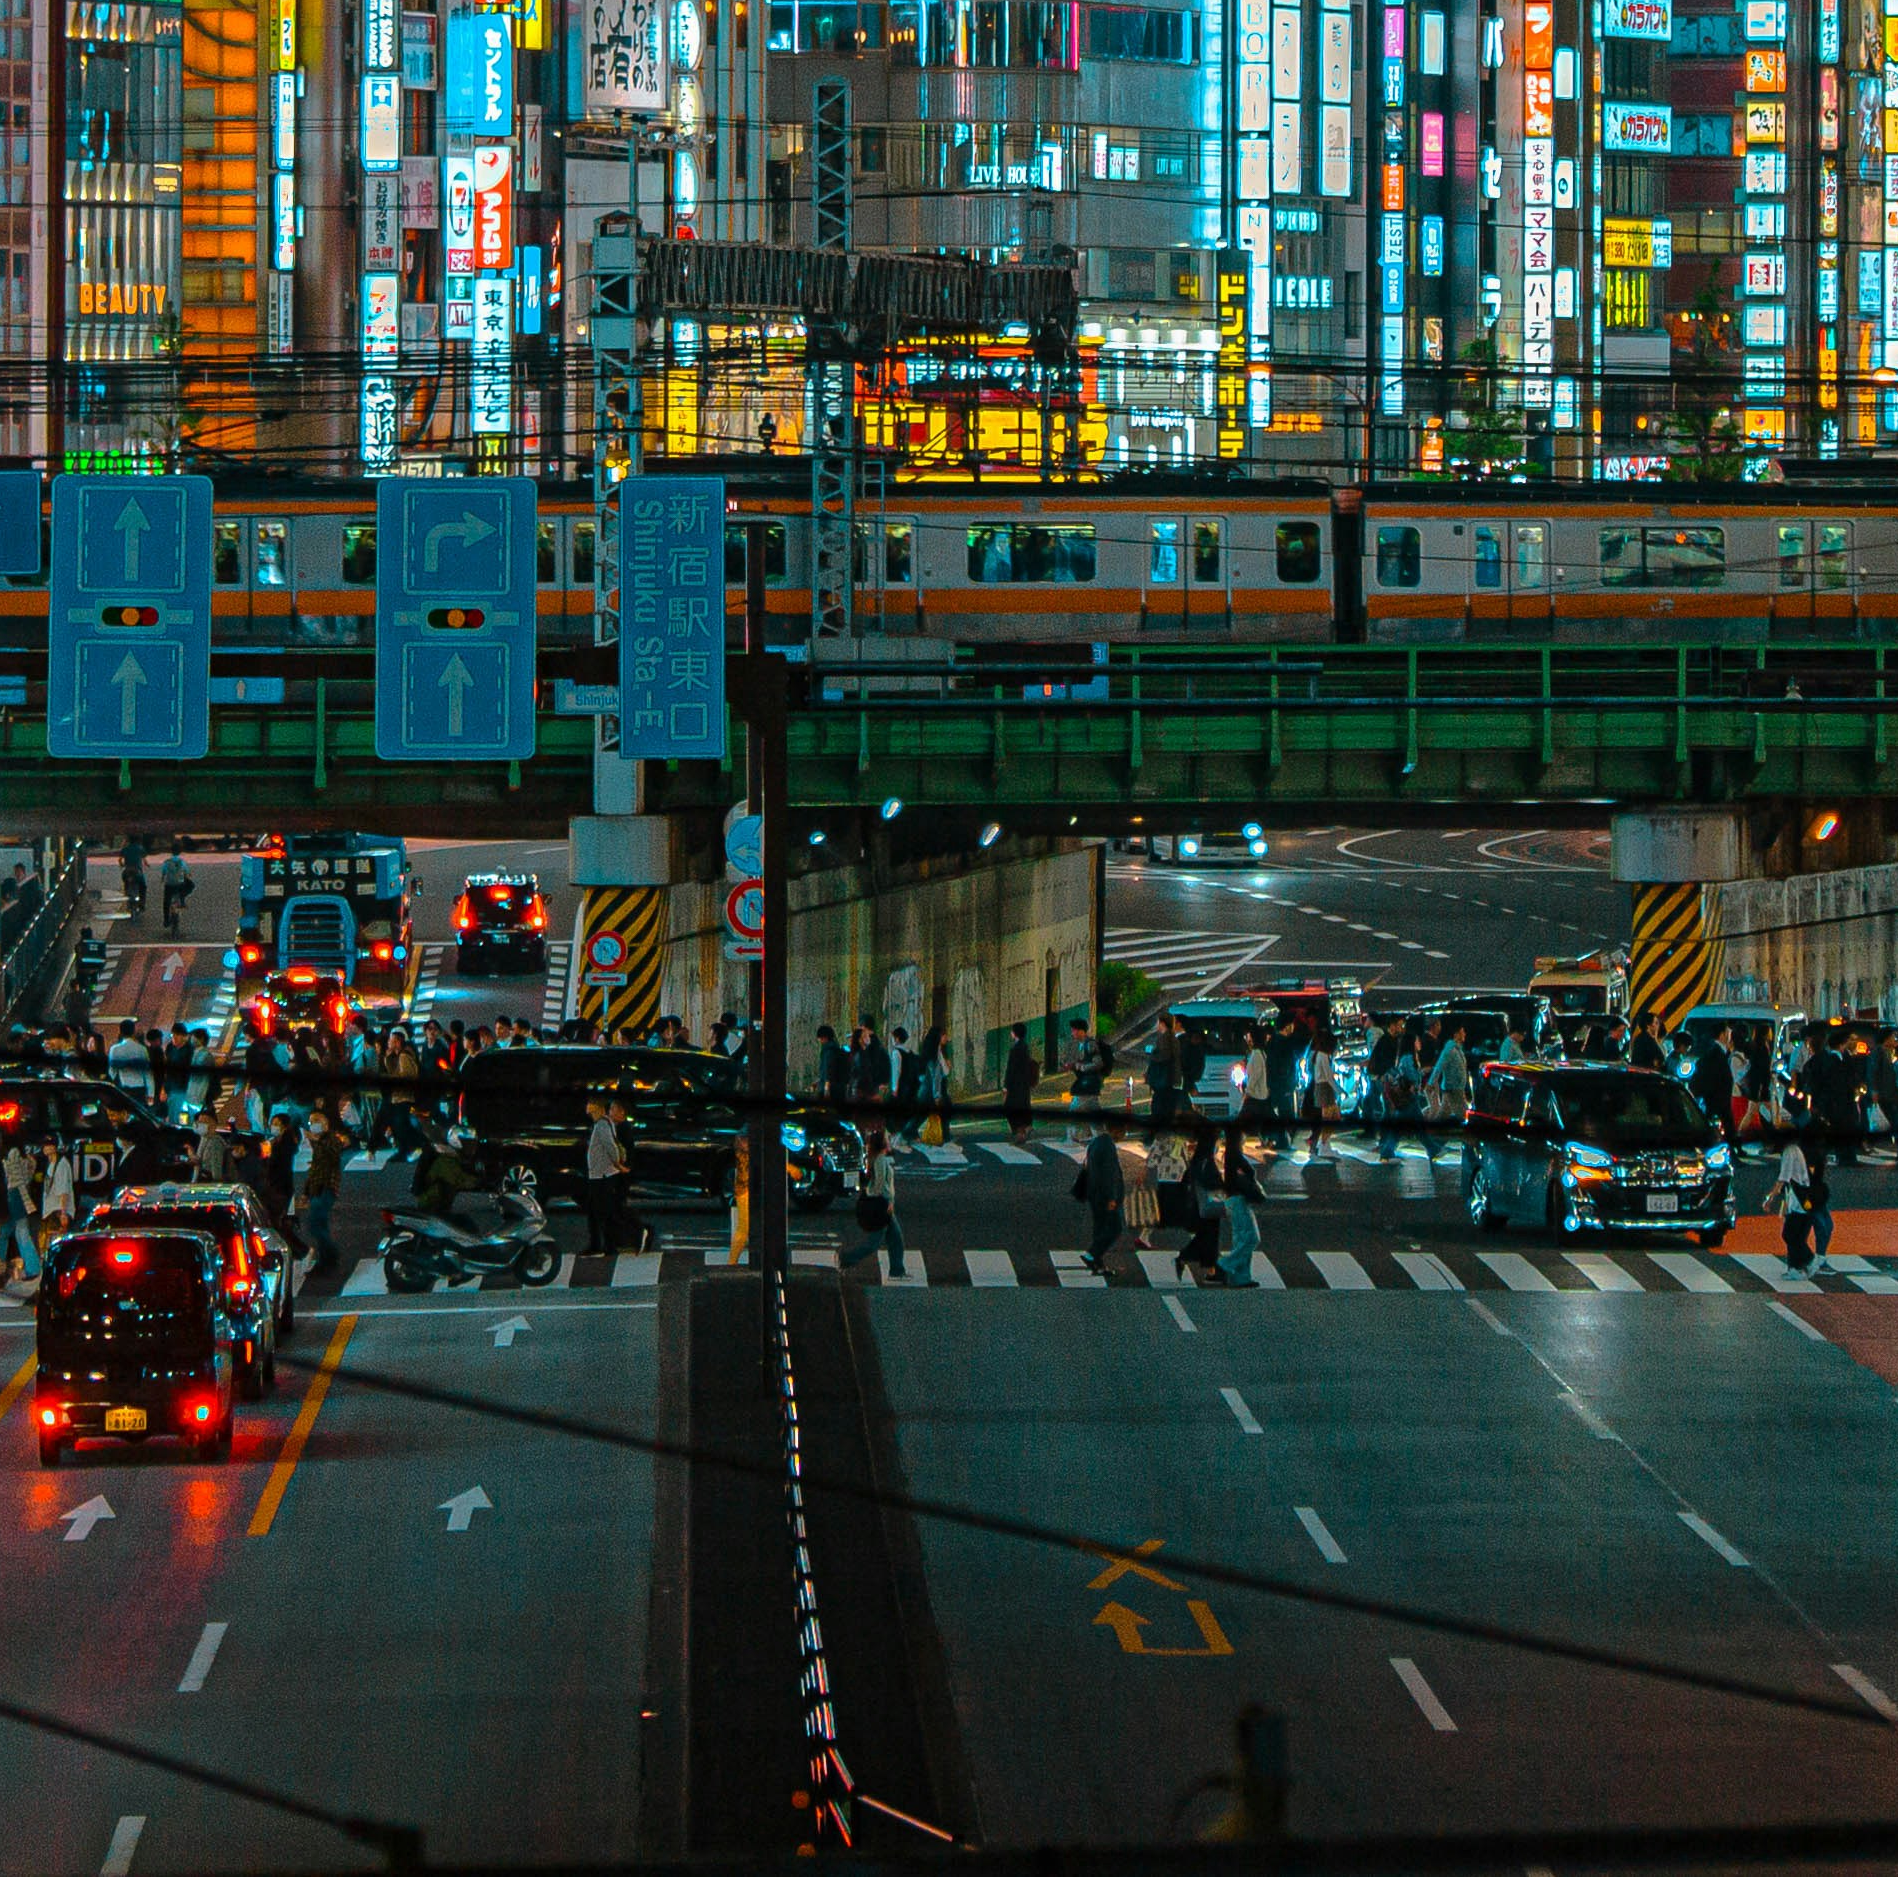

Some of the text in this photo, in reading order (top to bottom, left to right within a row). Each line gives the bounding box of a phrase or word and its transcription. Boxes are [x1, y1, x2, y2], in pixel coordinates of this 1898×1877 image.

[1628, 3, 1663, 30] カラオケ
[484, 28, 503, 122] セントラル
[1627, 115, 1663, 141] カラオケ
[969, 165, 1001, 184] LIVE
[482, 193, 502, 250] アコム
[1389, 218, 1403, 257] ZEST
[1529, 211, 1549, 269] ママ会
[483, 252, 501, 265] 3F
[79, 283, 166, 315] BEAUTY
[633, 499, 664, 622] Shinjuku
[667, 491, 710, 742] 新宿駅東口
[270, 860, 307, 875] 大矢
[297, 879, 346, 891] KATO
